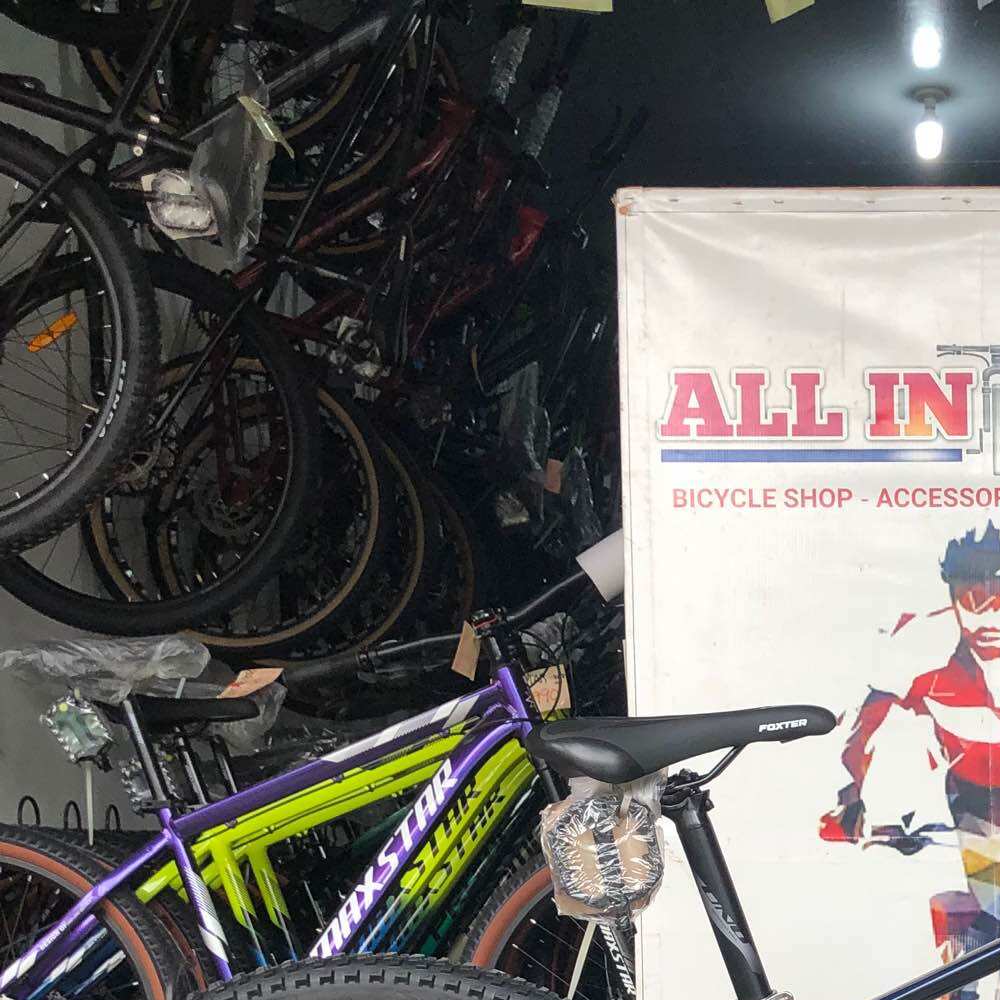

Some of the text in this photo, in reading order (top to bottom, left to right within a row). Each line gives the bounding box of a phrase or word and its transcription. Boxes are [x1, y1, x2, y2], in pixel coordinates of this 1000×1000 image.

[659, 370, 846, 438] ALL
[867, 370, 975, 438] IN
[672, 487, 777, 509] BICYCLE
[783, 487, 853, 509] SHOP
[758, 718, 808, 733] FOXTER
[309, 757, 458, 959] MAXSTAR
